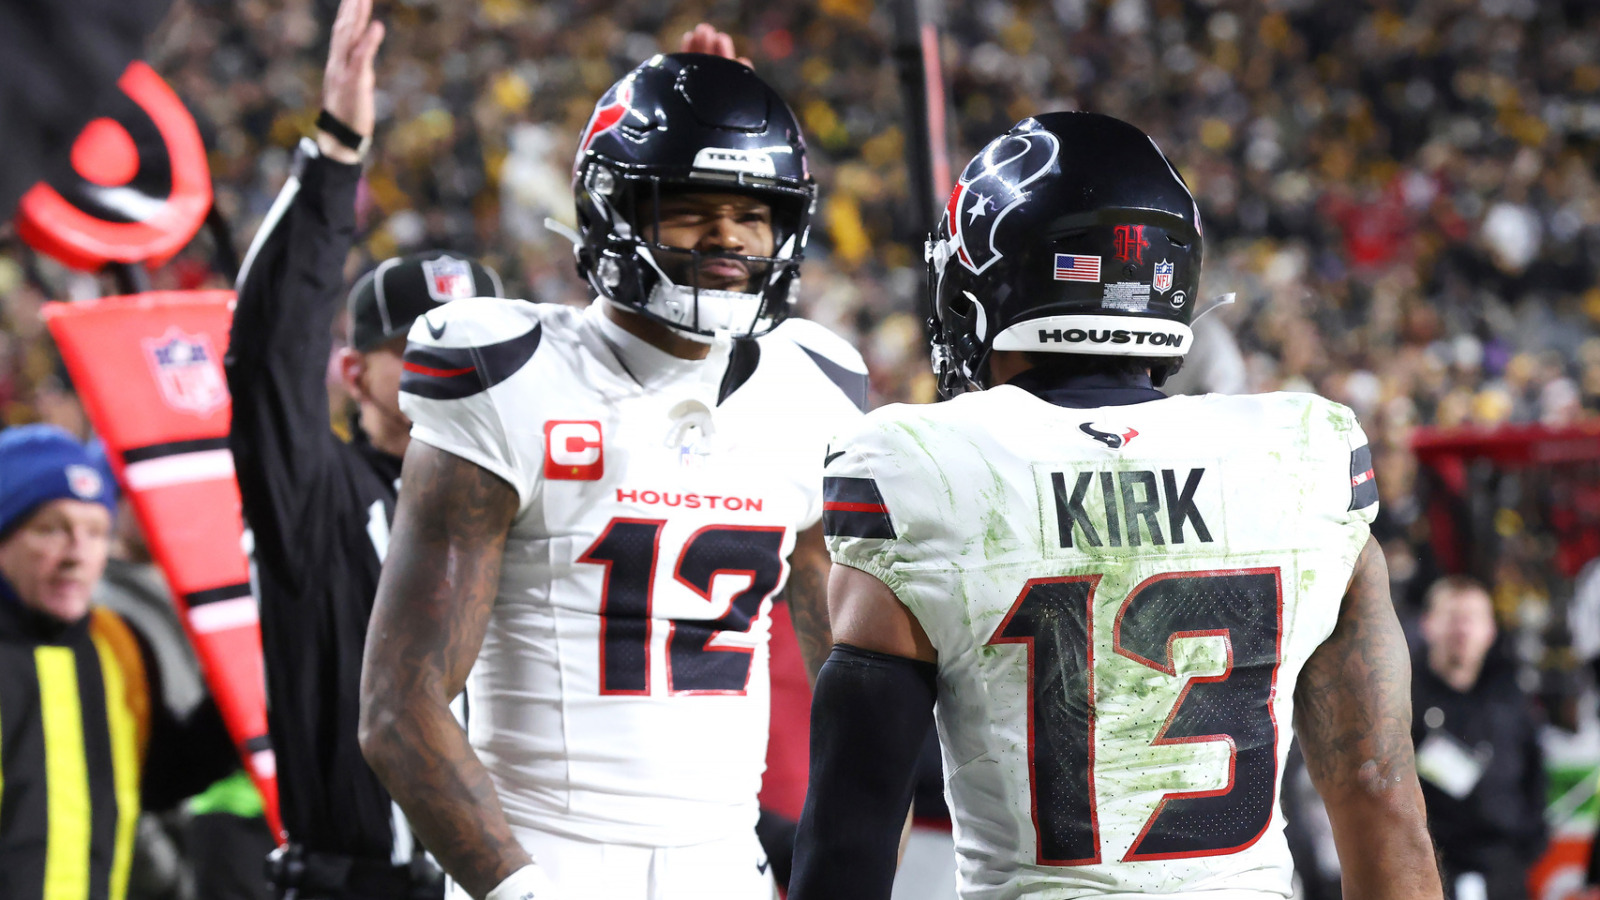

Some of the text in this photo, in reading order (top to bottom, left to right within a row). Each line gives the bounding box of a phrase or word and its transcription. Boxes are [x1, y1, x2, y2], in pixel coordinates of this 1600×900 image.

[708, 153, 767, 163] TEXA
[1112, 225, 1150, 265] H
[1155, 274, 1171, 288] NFL
[1038, 328, 1184, 348] HOUSTON
[549, 422, 601, 466] C
[616, 487, 763, 512] HOUSTON
[1050, 467, 1214, 548] KIRK
[574, 516, 787, 697] 12
[982, 566, 1285, 866] 13
